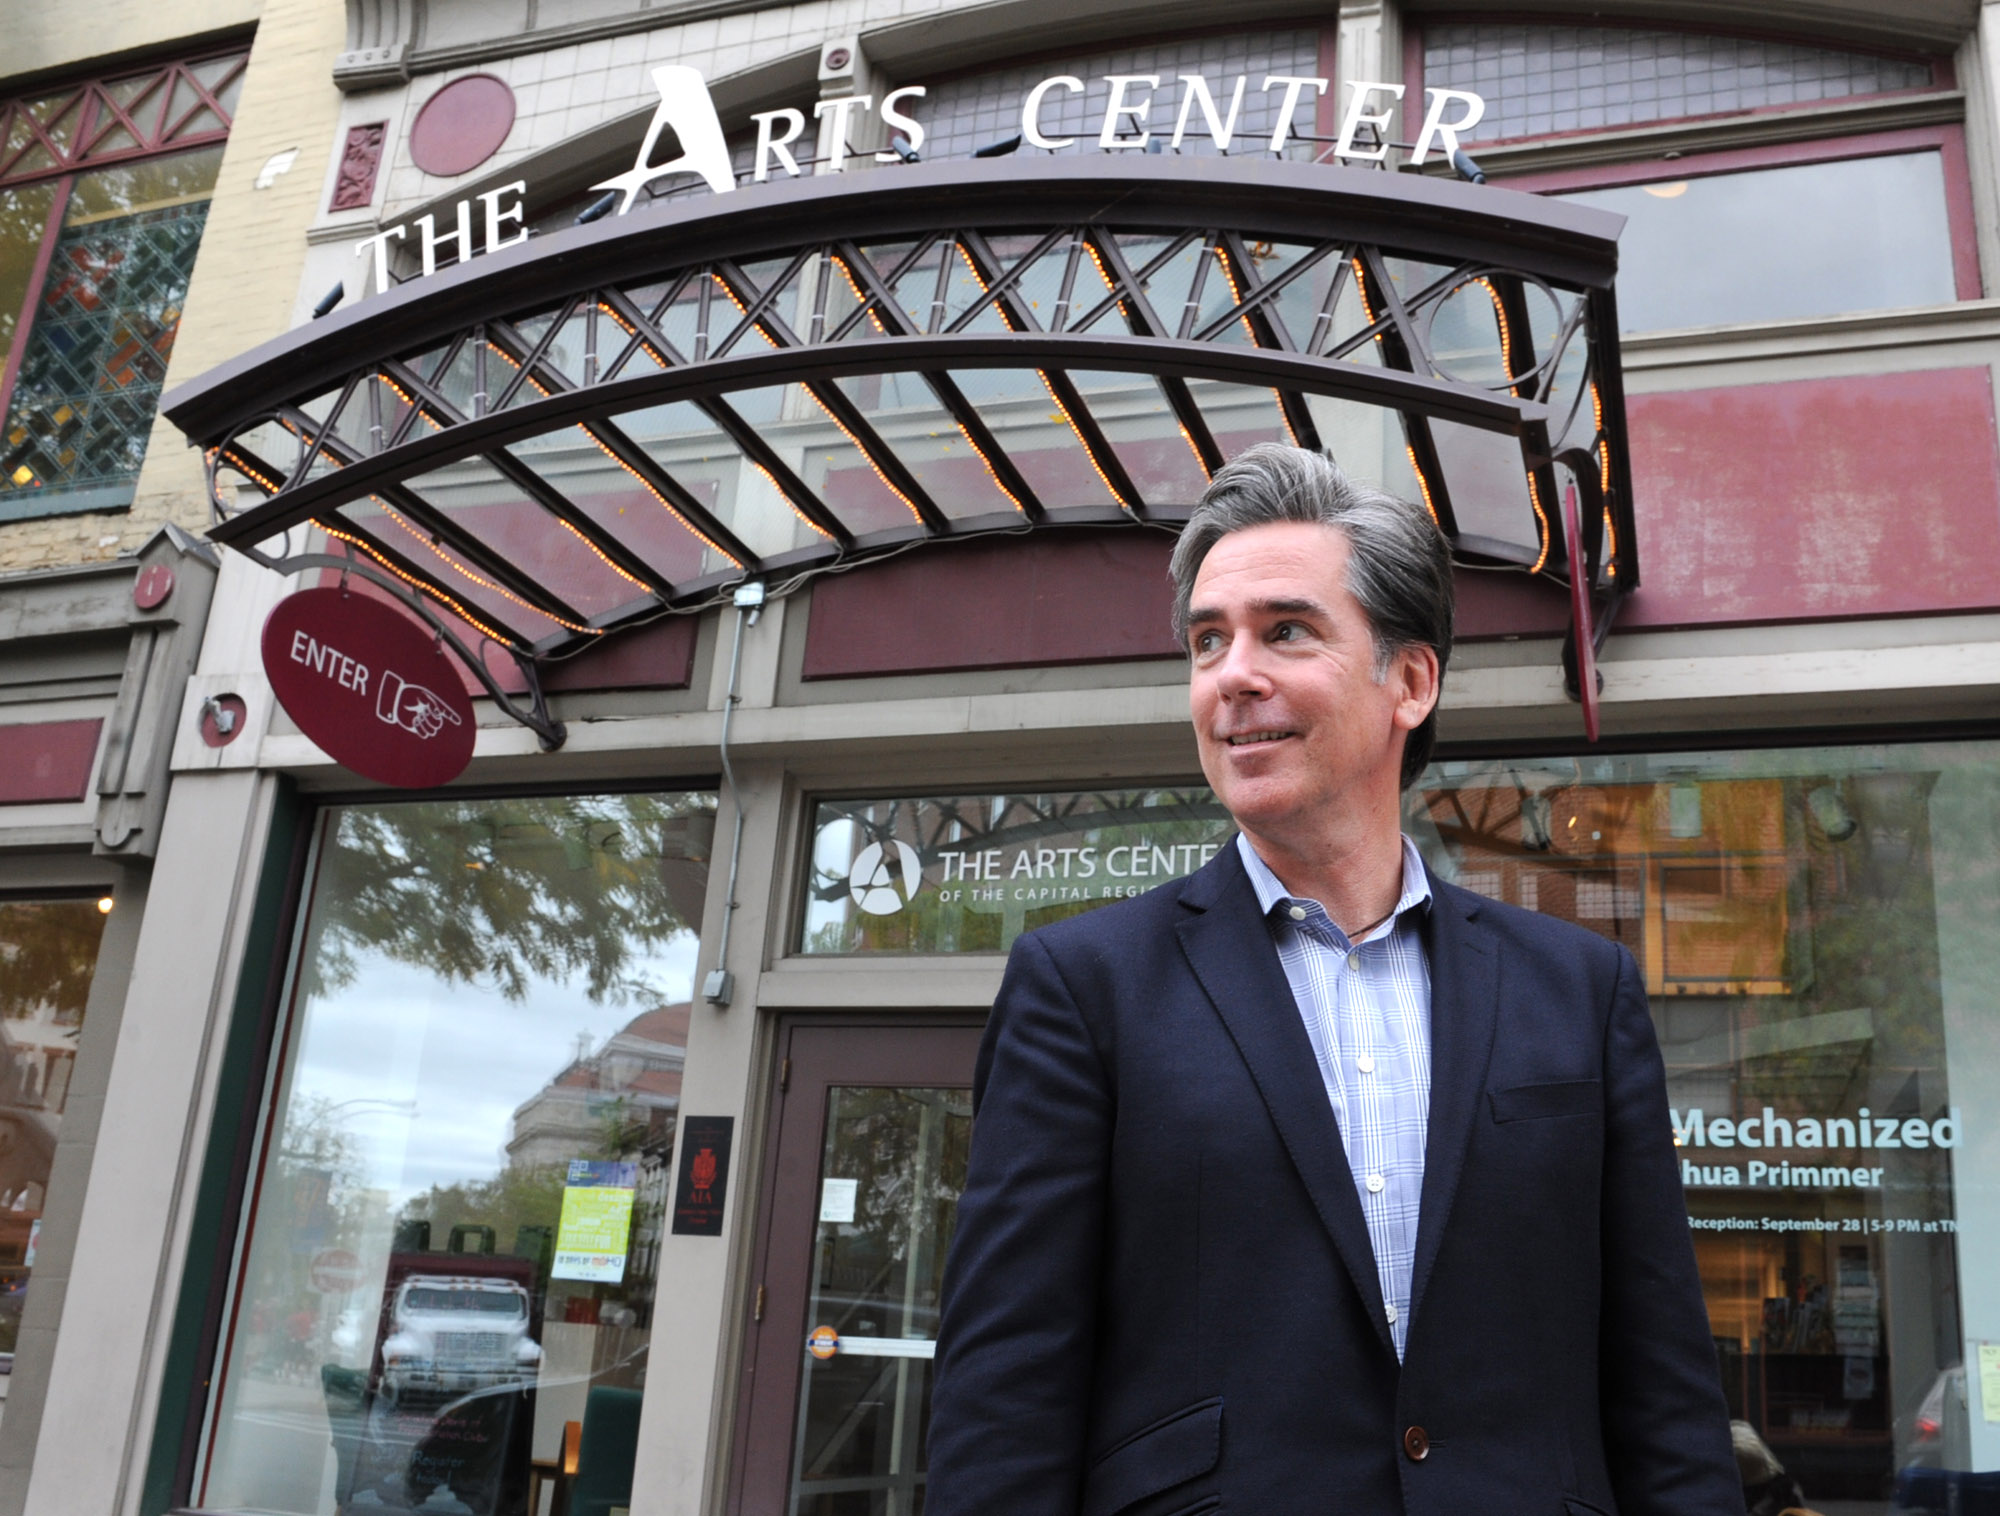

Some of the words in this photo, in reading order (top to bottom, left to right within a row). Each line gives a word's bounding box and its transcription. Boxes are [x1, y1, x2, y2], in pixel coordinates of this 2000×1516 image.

[355, 180, 529, 294] THE
[588, 65, 926, 216] ARTS
[1021, 74, 1486, 170] CENTER
[290, 630, 369, 696] ENTER
[938, 851, 1001, 881] THE
[1011, 848, 1095, 879] ARTS
[1105, 843, 1226, 877] CENTE
[940, 890, 962, 902] OF
[972, 889, 1004, 901] THE
[1014, 886, 1090, 900] CAPITAL
[1102, 885, 1159, 898] REGI
[1670, 1106, 1963, 1148] Mechanized
[1681, 1159, 1740, 1185] hua
[1748, 1161, 1884, 1187] Primmer
[1761, 1217, 1840, 1232] September
[1842, 1219, 1860, 1232] 28
[1871, 1220, 1894, 1232] 5-9
[1897, 1220, 1920, 1232] PM
[1923, 1221, 1938, 1232] at
